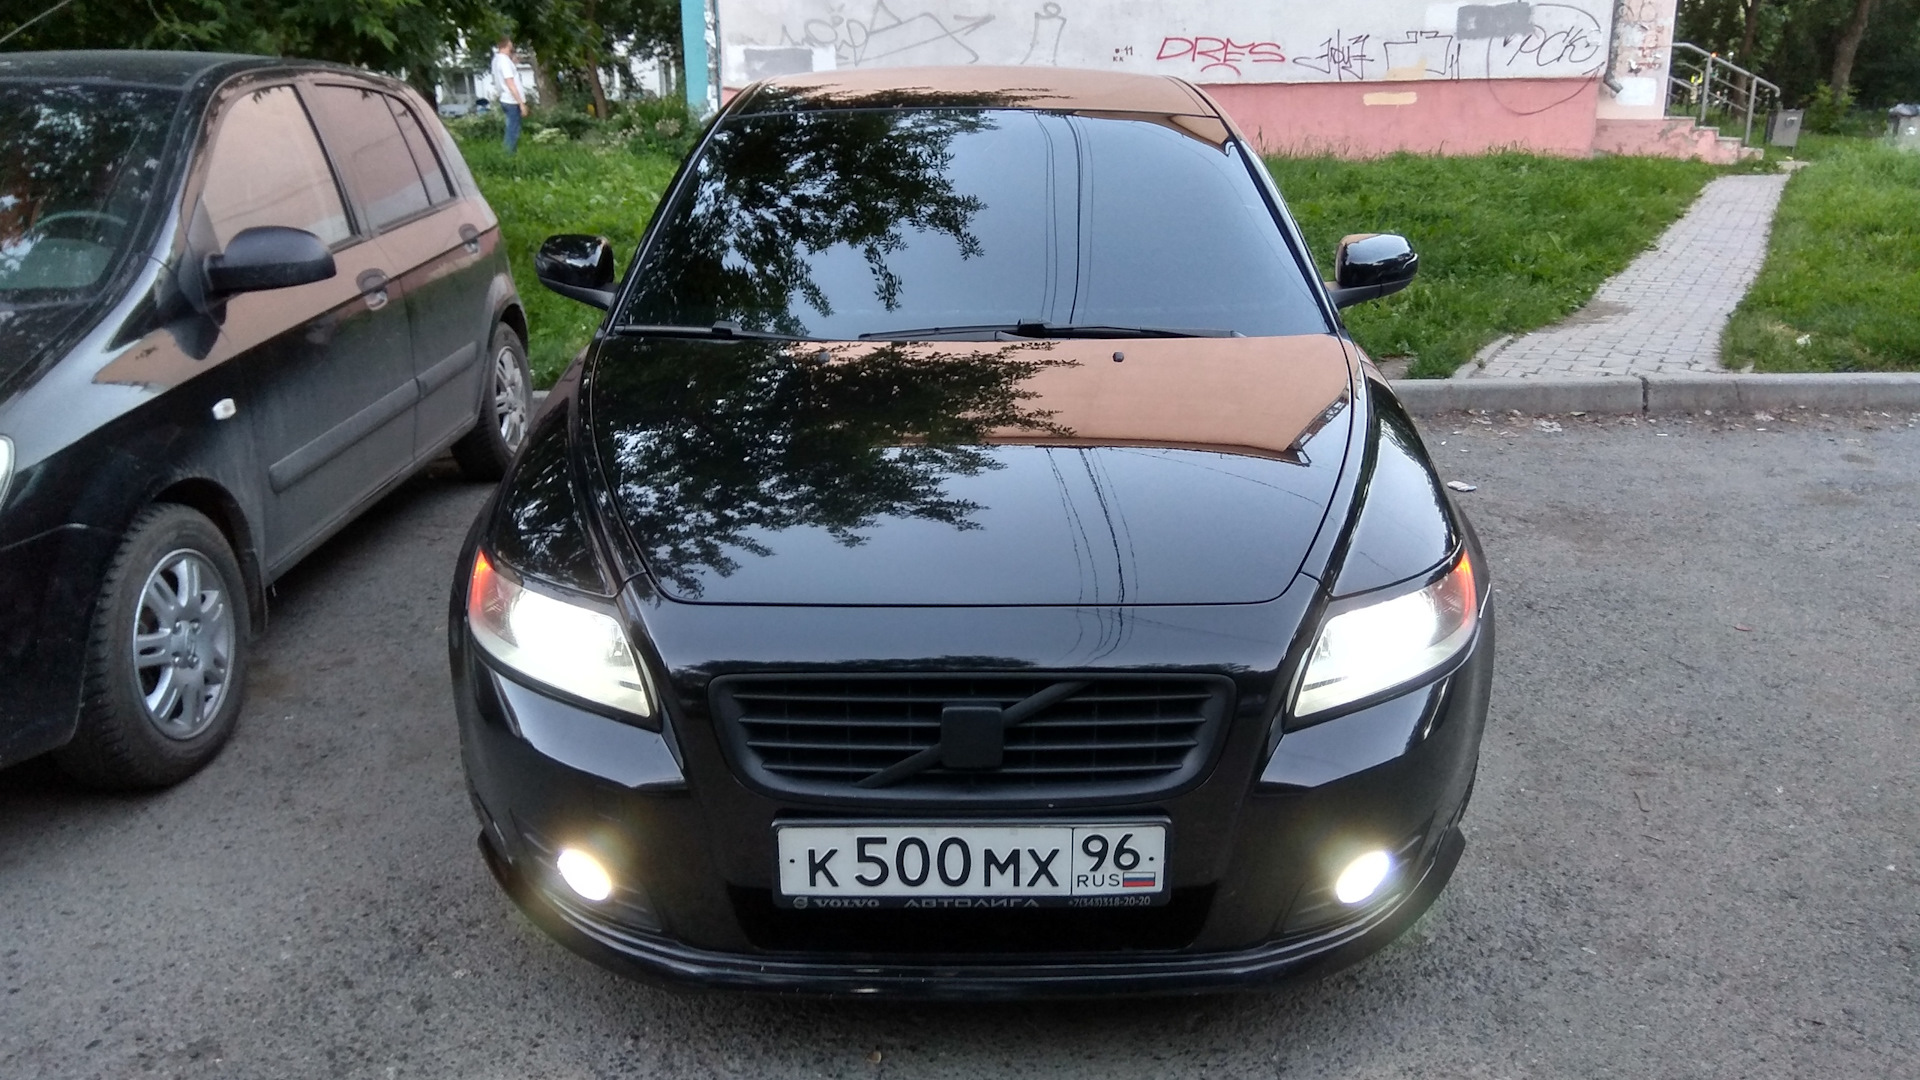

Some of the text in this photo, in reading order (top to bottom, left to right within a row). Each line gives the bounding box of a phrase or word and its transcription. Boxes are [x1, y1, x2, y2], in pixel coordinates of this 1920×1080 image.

[1081, 833, 1140, 872] 96
[1077, 874, 1120, 888] RUS
[813, 899, 880, 908] VOLVO
